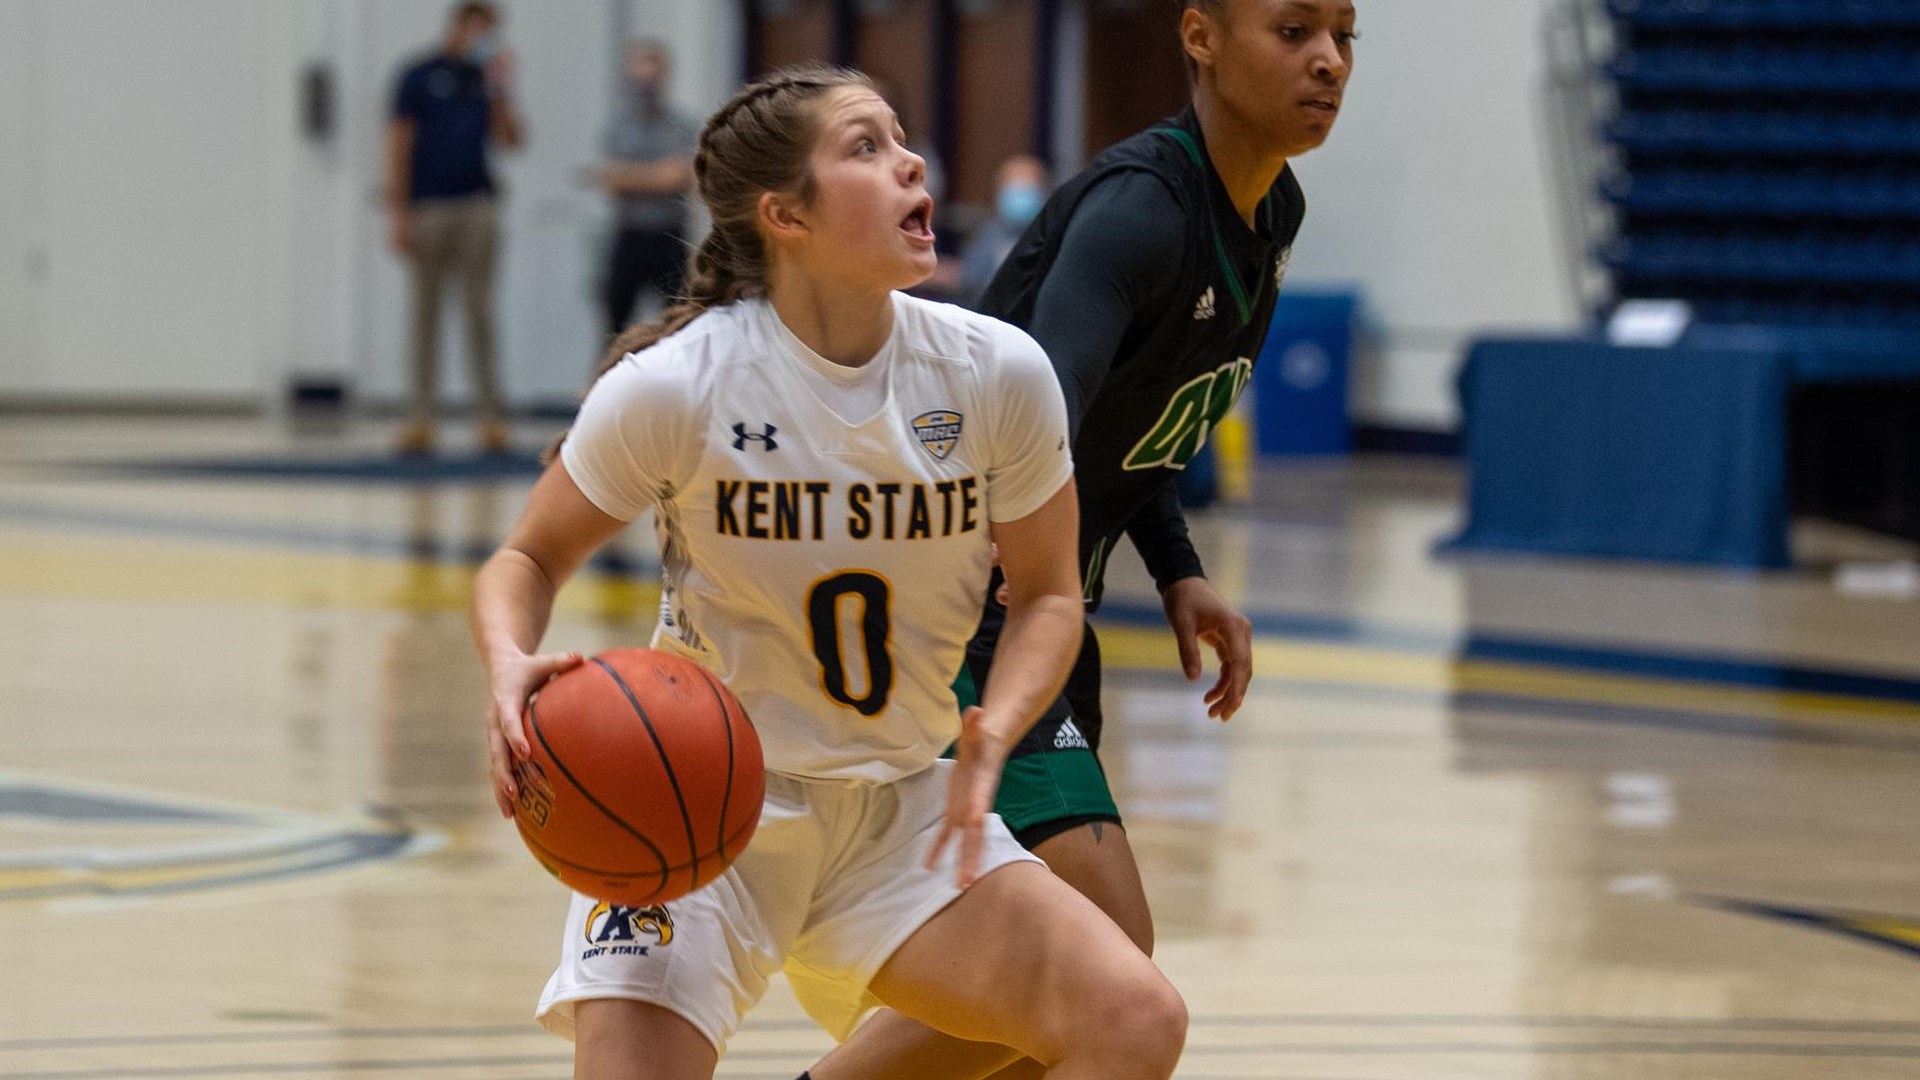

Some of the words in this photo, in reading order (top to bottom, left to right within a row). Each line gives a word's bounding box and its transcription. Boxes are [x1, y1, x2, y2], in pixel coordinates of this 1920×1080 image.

[715, 479, 831, 541] KENT
[846, 476, 979, 541] STATE
[805, 568, 895, 719] 0
[581, 946, 608, 961] KENT
[610, 945, 650, 957] STATE
